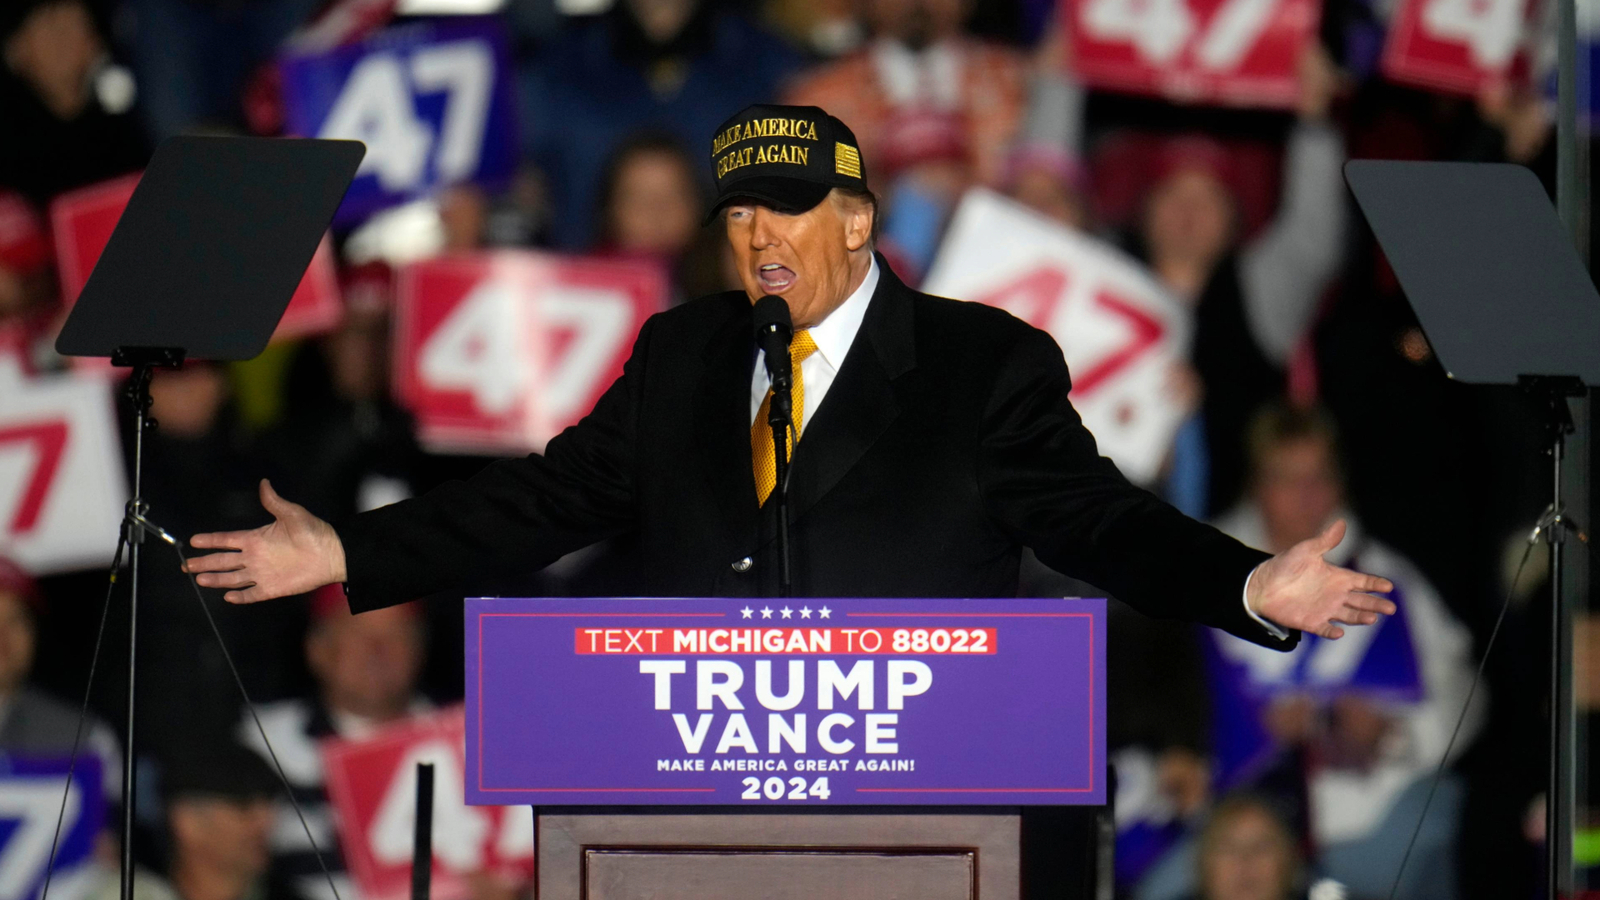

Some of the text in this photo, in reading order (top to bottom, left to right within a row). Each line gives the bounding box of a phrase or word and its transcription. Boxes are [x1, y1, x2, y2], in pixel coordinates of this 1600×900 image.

[314, 40, 497, 191] 47
[712, 118, 818, 157] MAKE AMERICA
[718, 145, 809, 179] GREAT AGAIN
[417, 285, 636, 413] 47
[584, 629, 988, 653] TEXT MICHIGAN TO 88022
[639, 659, 933, 711] TRUMP
[672, 713, 899, 755] VANCE
[657, 759, 915, 772] MAKE AMERICA GREAT AGAIN!
[741, 776, 831, 800] 2024
